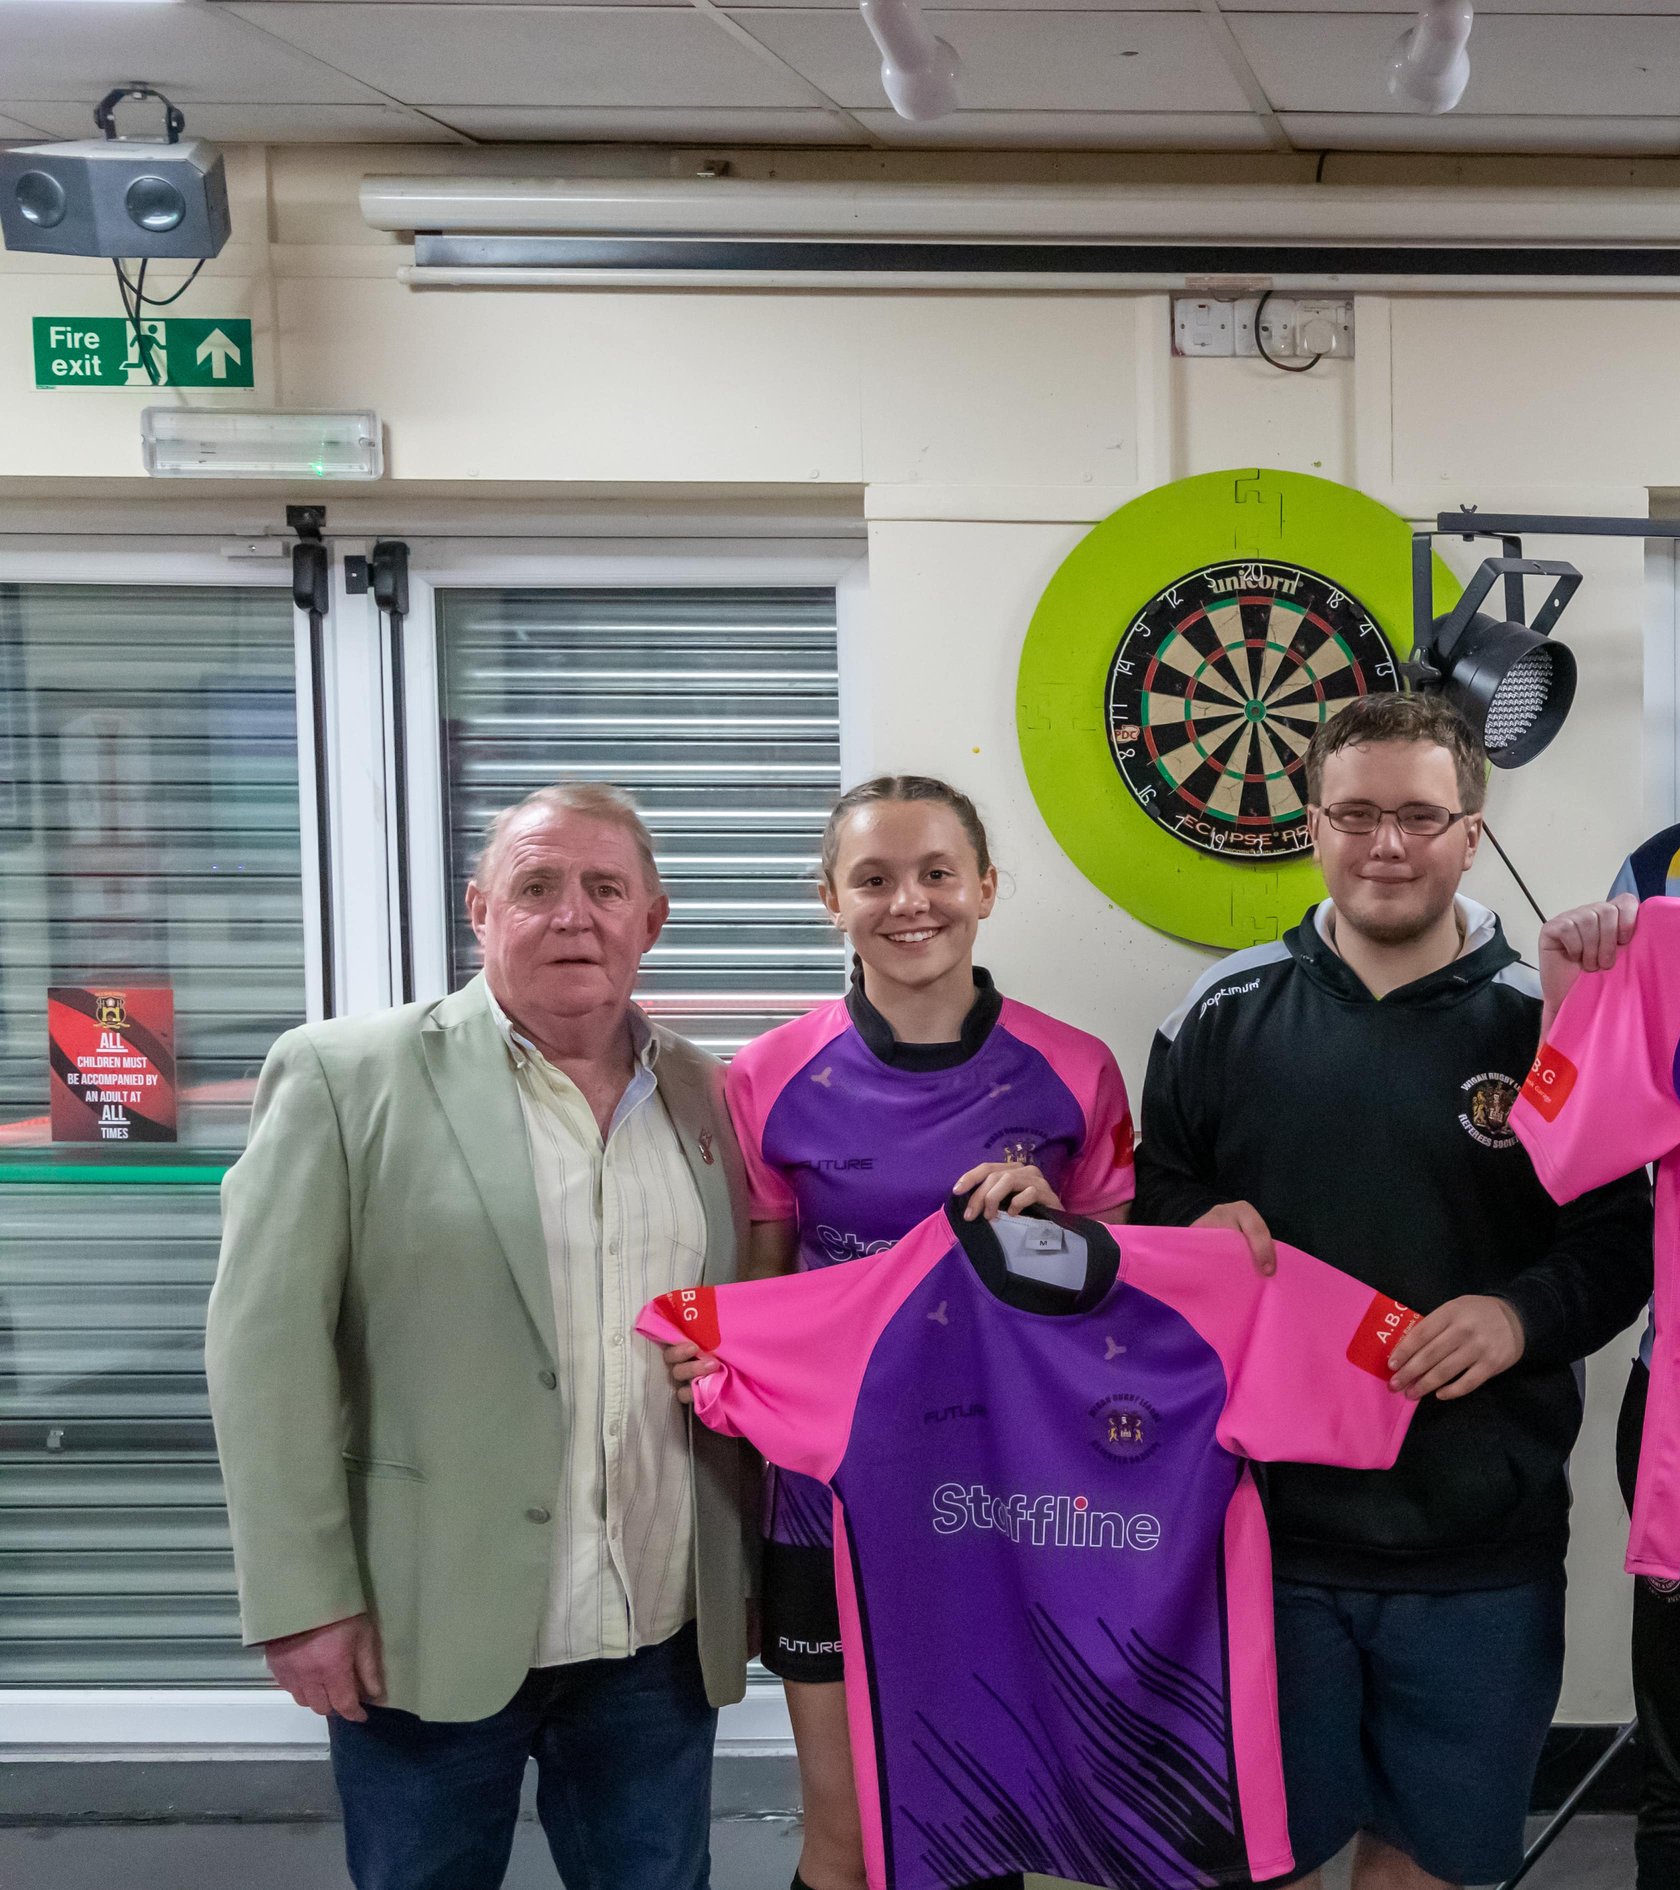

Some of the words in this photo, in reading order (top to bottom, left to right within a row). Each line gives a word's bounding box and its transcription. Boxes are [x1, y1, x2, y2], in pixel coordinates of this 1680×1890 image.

[49, 327, 100, 349] Fire
[51, 354, 102, 376] exit
[1240, 562, 1264, 582] 20
[1211, 569, 1297, 596] unicorn
[1159, 588, 1184, 610] 12
[1326, 587, 1346, 609] 18
[1359, 623, 1374, 637] 4
[1114, 730, 1138, 741] PDC
[1117, 748, 1136, 761] 8
[1183, 813, 1273, 846] ECLIPSE
[100, 1032, 125, 1049] ALL
[77, 1056, 121, 1068] CHILDREN
[122, 1056, 148, 1068] MUST
[67, 1074, 80, 1085] BE
[81, 1073, 144, 1086] ACCOMPANIED
[145, 1074, 158, 1086] BY
[1460, 1073, 1488, 1092] WIGAN
[85, 1091, 98, 1102] AN
[99, 1091, 128, 1103] ADULT
[129, 1091, 142, 1103] AT
[102, 1104, 127, 1121] ALL
[100, 1127, 129, 1139] TIMES
[1458, 1113, 1493, 1147] REFEREES
[924, 1404, 989, 1425] FUTUR
[779, 1636, 843, 1654] FUTURE
